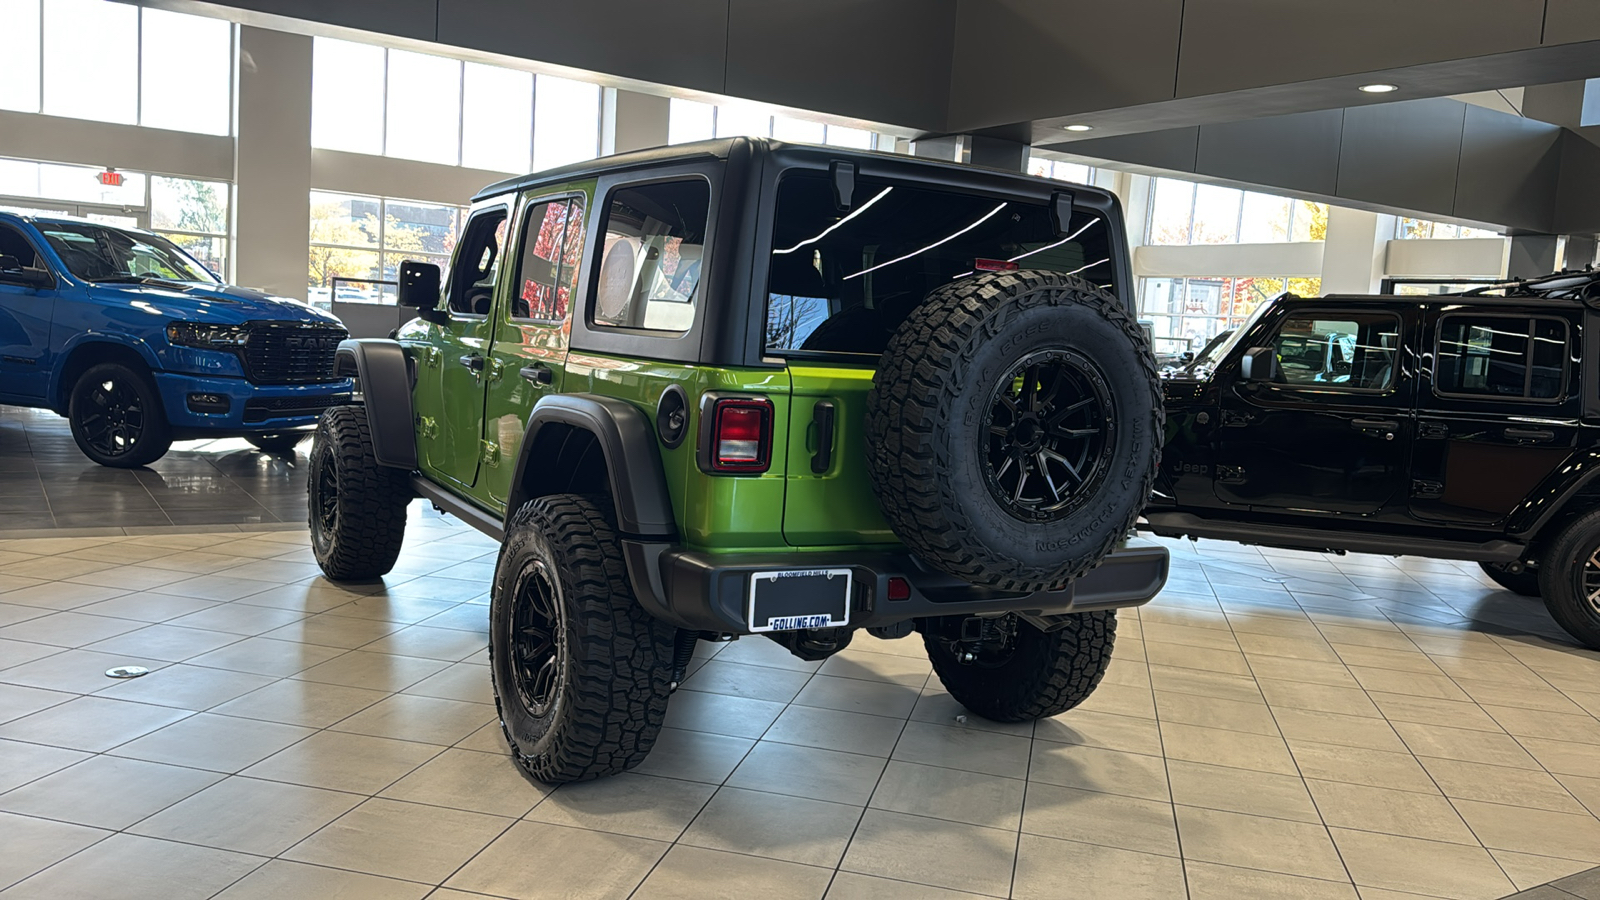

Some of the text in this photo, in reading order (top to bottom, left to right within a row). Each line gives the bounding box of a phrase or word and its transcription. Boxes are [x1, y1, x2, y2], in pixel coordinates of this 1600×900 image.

[285, 337, 333, 348] RAM
[1173, 460, 1209, 475] Jeep
[1035, 501, 1119, 554] THOMPSON
[773, 616, 827, 630] GOLLING.COM
